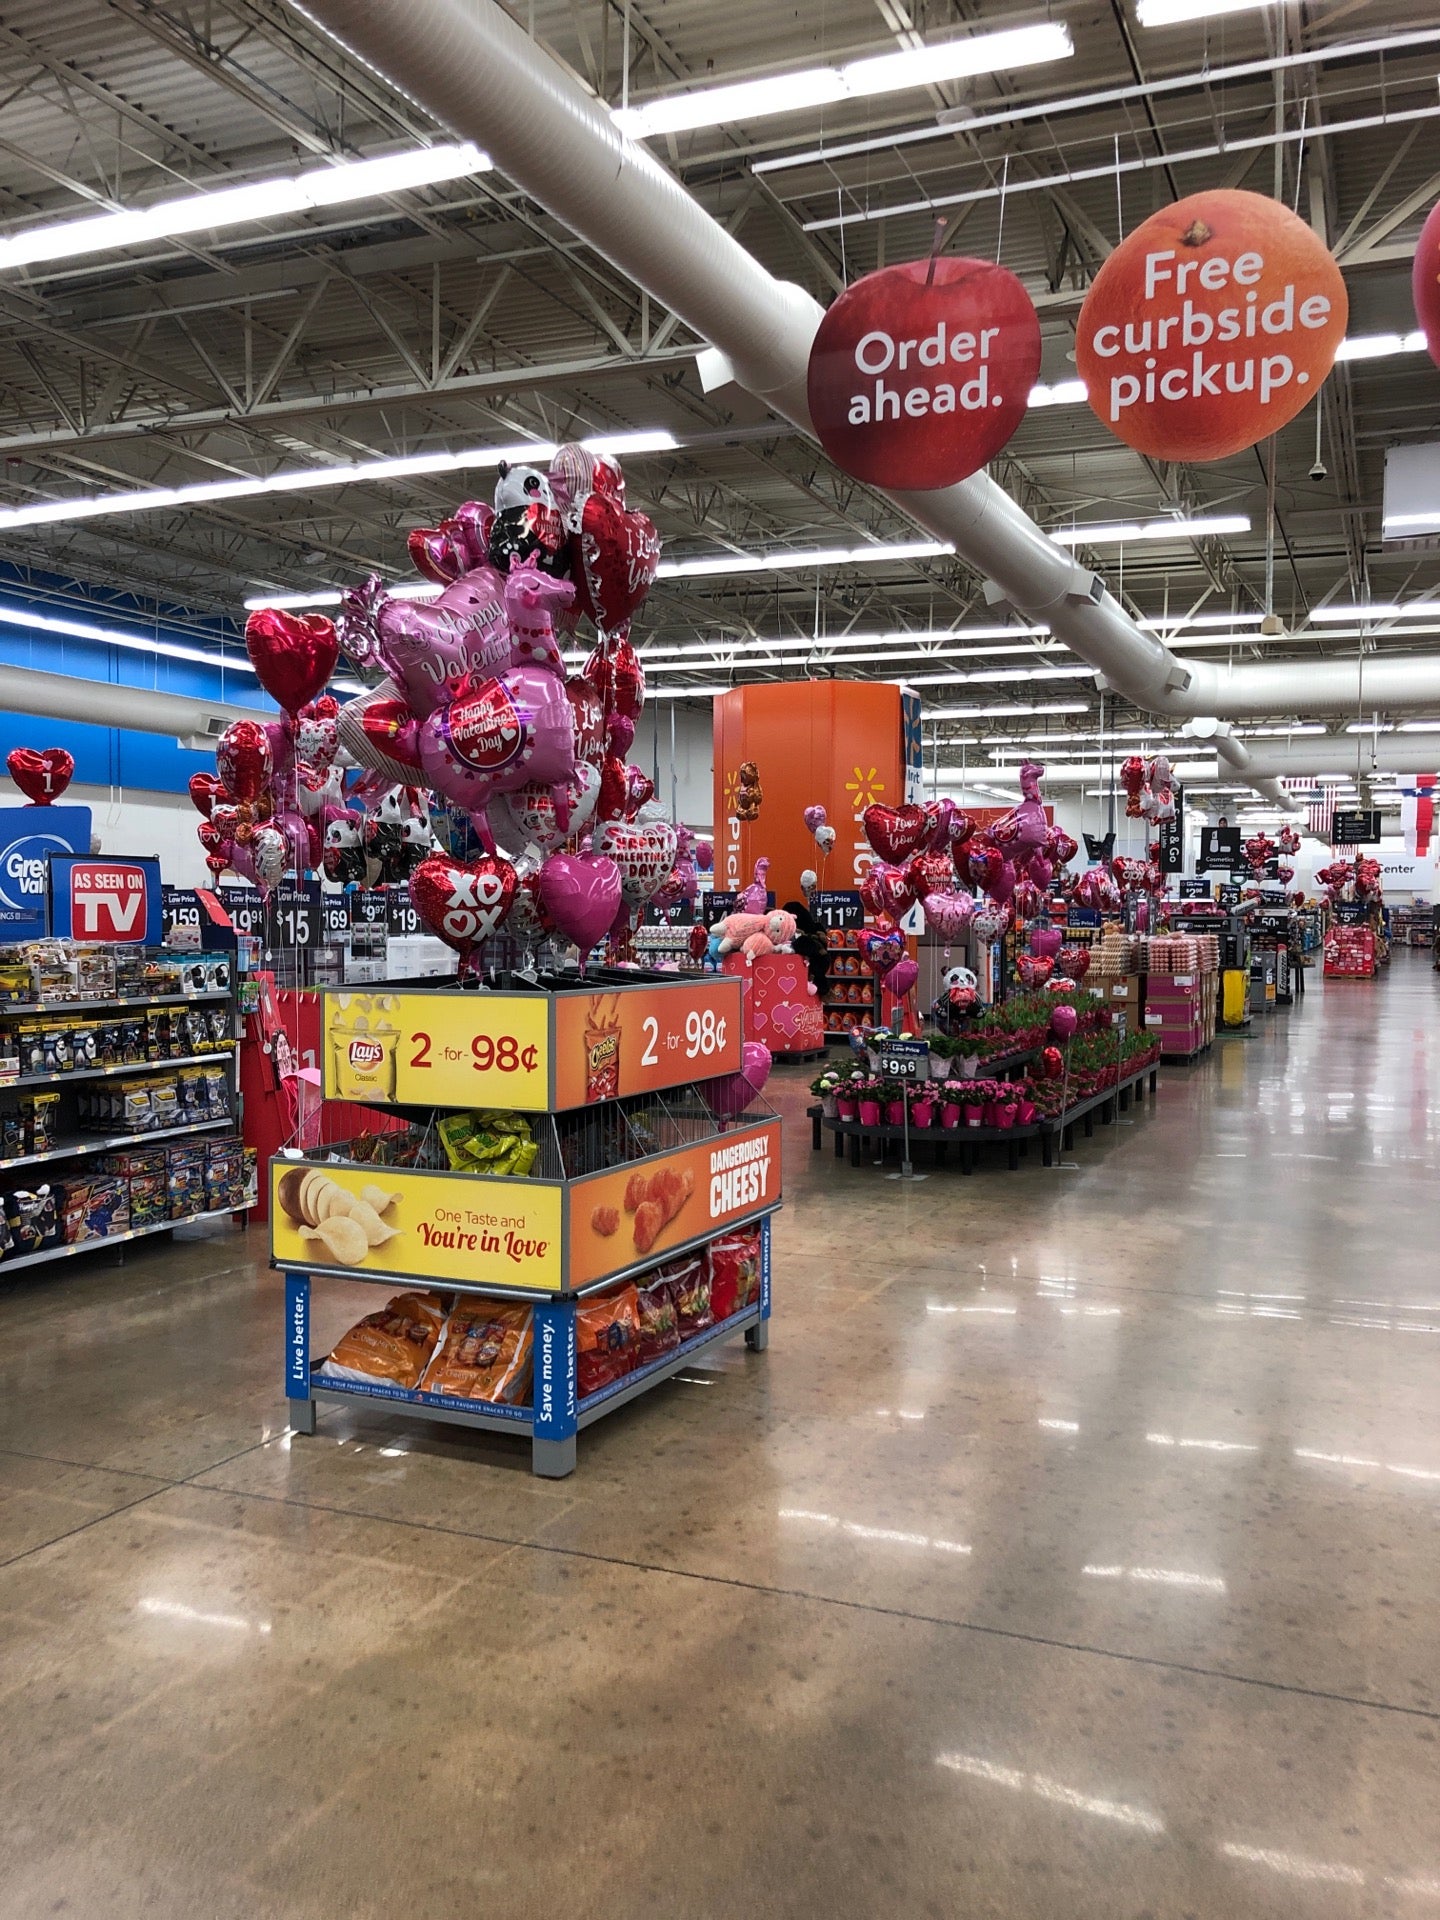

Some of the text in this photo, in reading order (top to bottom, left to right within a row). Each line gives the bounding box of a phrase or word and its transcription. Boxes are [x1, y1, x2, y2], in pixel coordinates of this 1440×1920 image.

[1145, 249, 1264, 299] Free
[1093, 285, 1331, 358] curbside
[855, 322, 1000, 375] Order
[848, 365, 1003, 426] ahead.
[1110, 352, 1310, 422] pickup.
[625, 526, 633, 556] I
[437, 600, 509, 644] Happy
[452, 709, 516, 741] Valentine's
[458, 701, 494, 723] Happy
[477, 735, 503, 752] Day
[884, 819, 890, 833] I
[887, 834, 916, 851] You
[616, 837, 666, 850] HAPPY
[1170, 847, 1180, 863] Go
[74, 873, 144, 889] AS SEEN ON
[629, 864, 657, 878] DAY
[168, 895, 196, 903] Low Price
[229, 894, 262, 903] Low Price
[278, 891, 311, 902] Low Price
[445, 869, 502, 909] XO
[74, 892, 142, 933] TV
[443, 905, 503, 942] OX
[351, 1042, 381, 1062] Lay's
[410, 1032, 432, 1068] 2
[471, 1034, 539, 1073] 98¢
[641, 1016, 659, 1066] 2
[685, 1009, 727, 1059] 98¢
[710, 1135, 769, 1174] DANGEROUSLY
[710, 1157, 769, 1218] CHEESY
[435, 1208, 525, 1229] One Taste and
[417, 1222, 548, 1263] You're in Love
[293, 1291, 304, 1380] Live better.
[540, 1319, 555, 1422] Save money.
[566, 1319, 575, 1416] Live better.
[332, 1380, 346, 1388] YOUR
[347, 1383, 371, 1391] FAVORITE
[371, 1387, 392, 1395] SNACKS
[456, 1401, 481, 1411] FAVORITE
[483, 1405, 504, 1414] SNACKS
[514, 1410, 523, 1418] GO
